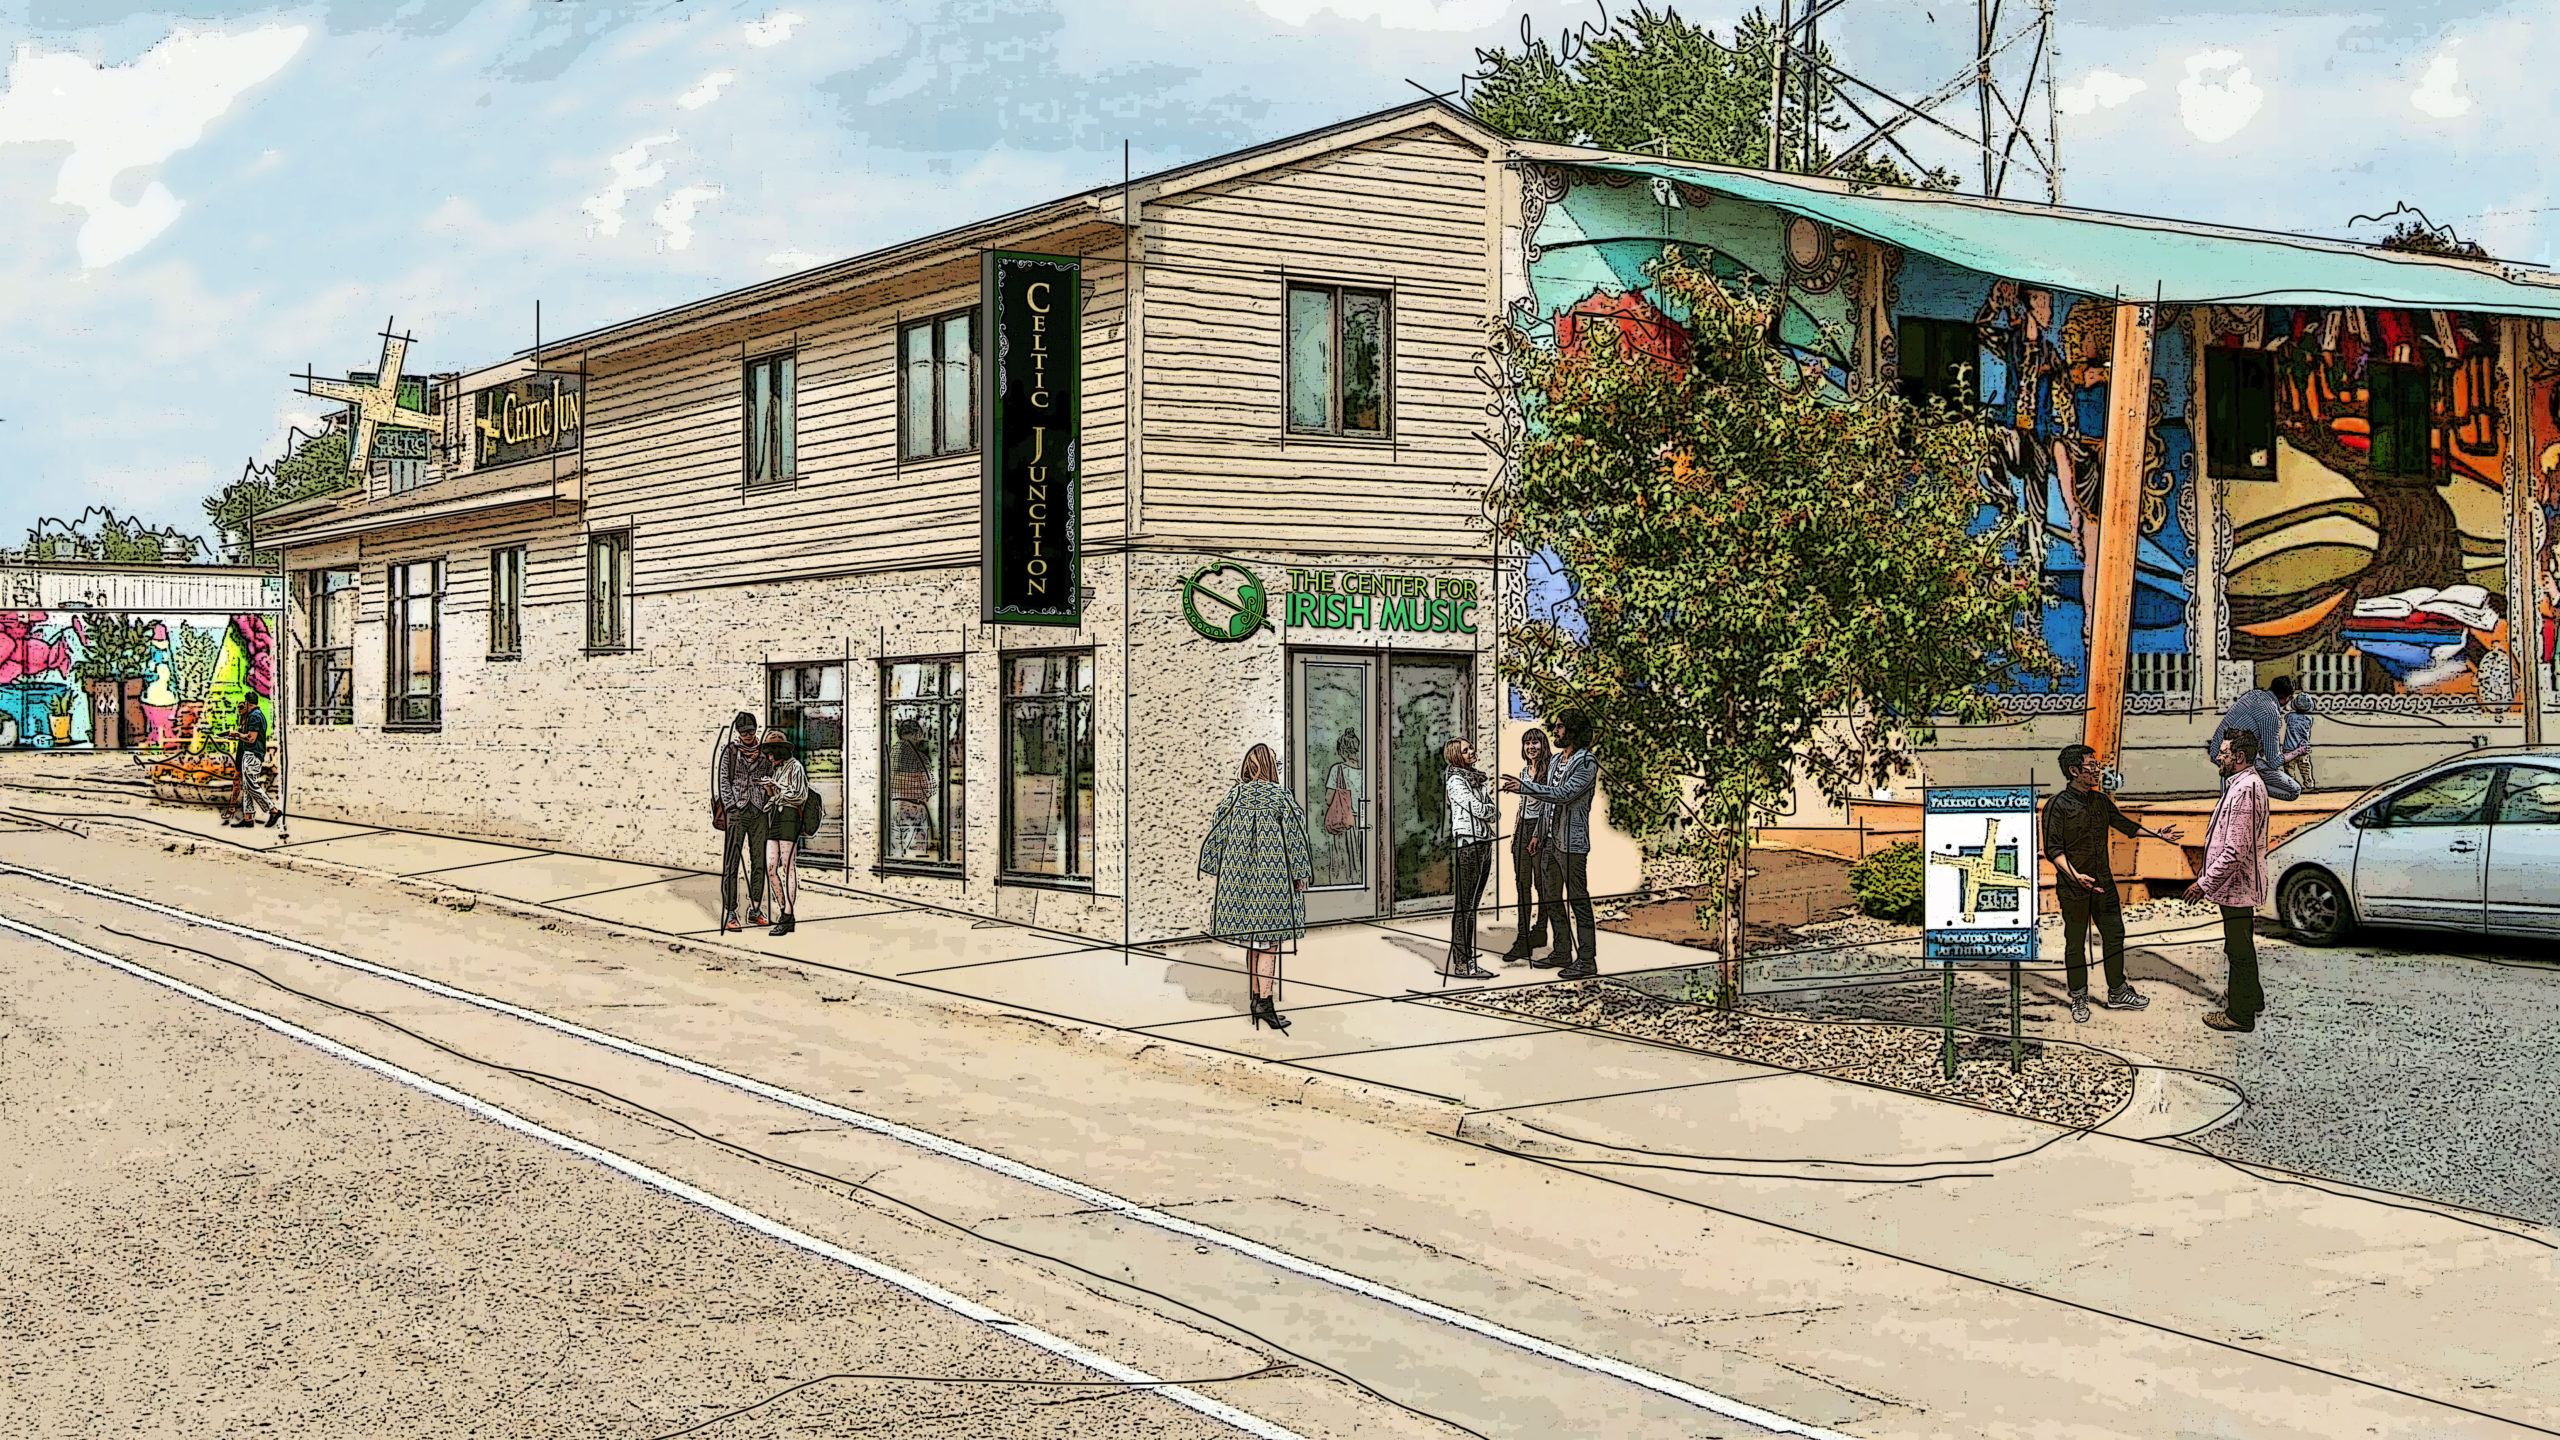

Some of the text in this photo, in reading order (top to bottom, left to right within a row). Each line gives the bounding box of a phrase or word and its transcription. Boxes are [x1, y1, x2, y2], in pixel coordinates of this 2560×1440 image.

[1287, 570, 1477, 599] THE CENTER FOR
[1286, 592, 1478, 633] IRISH MUSIC
